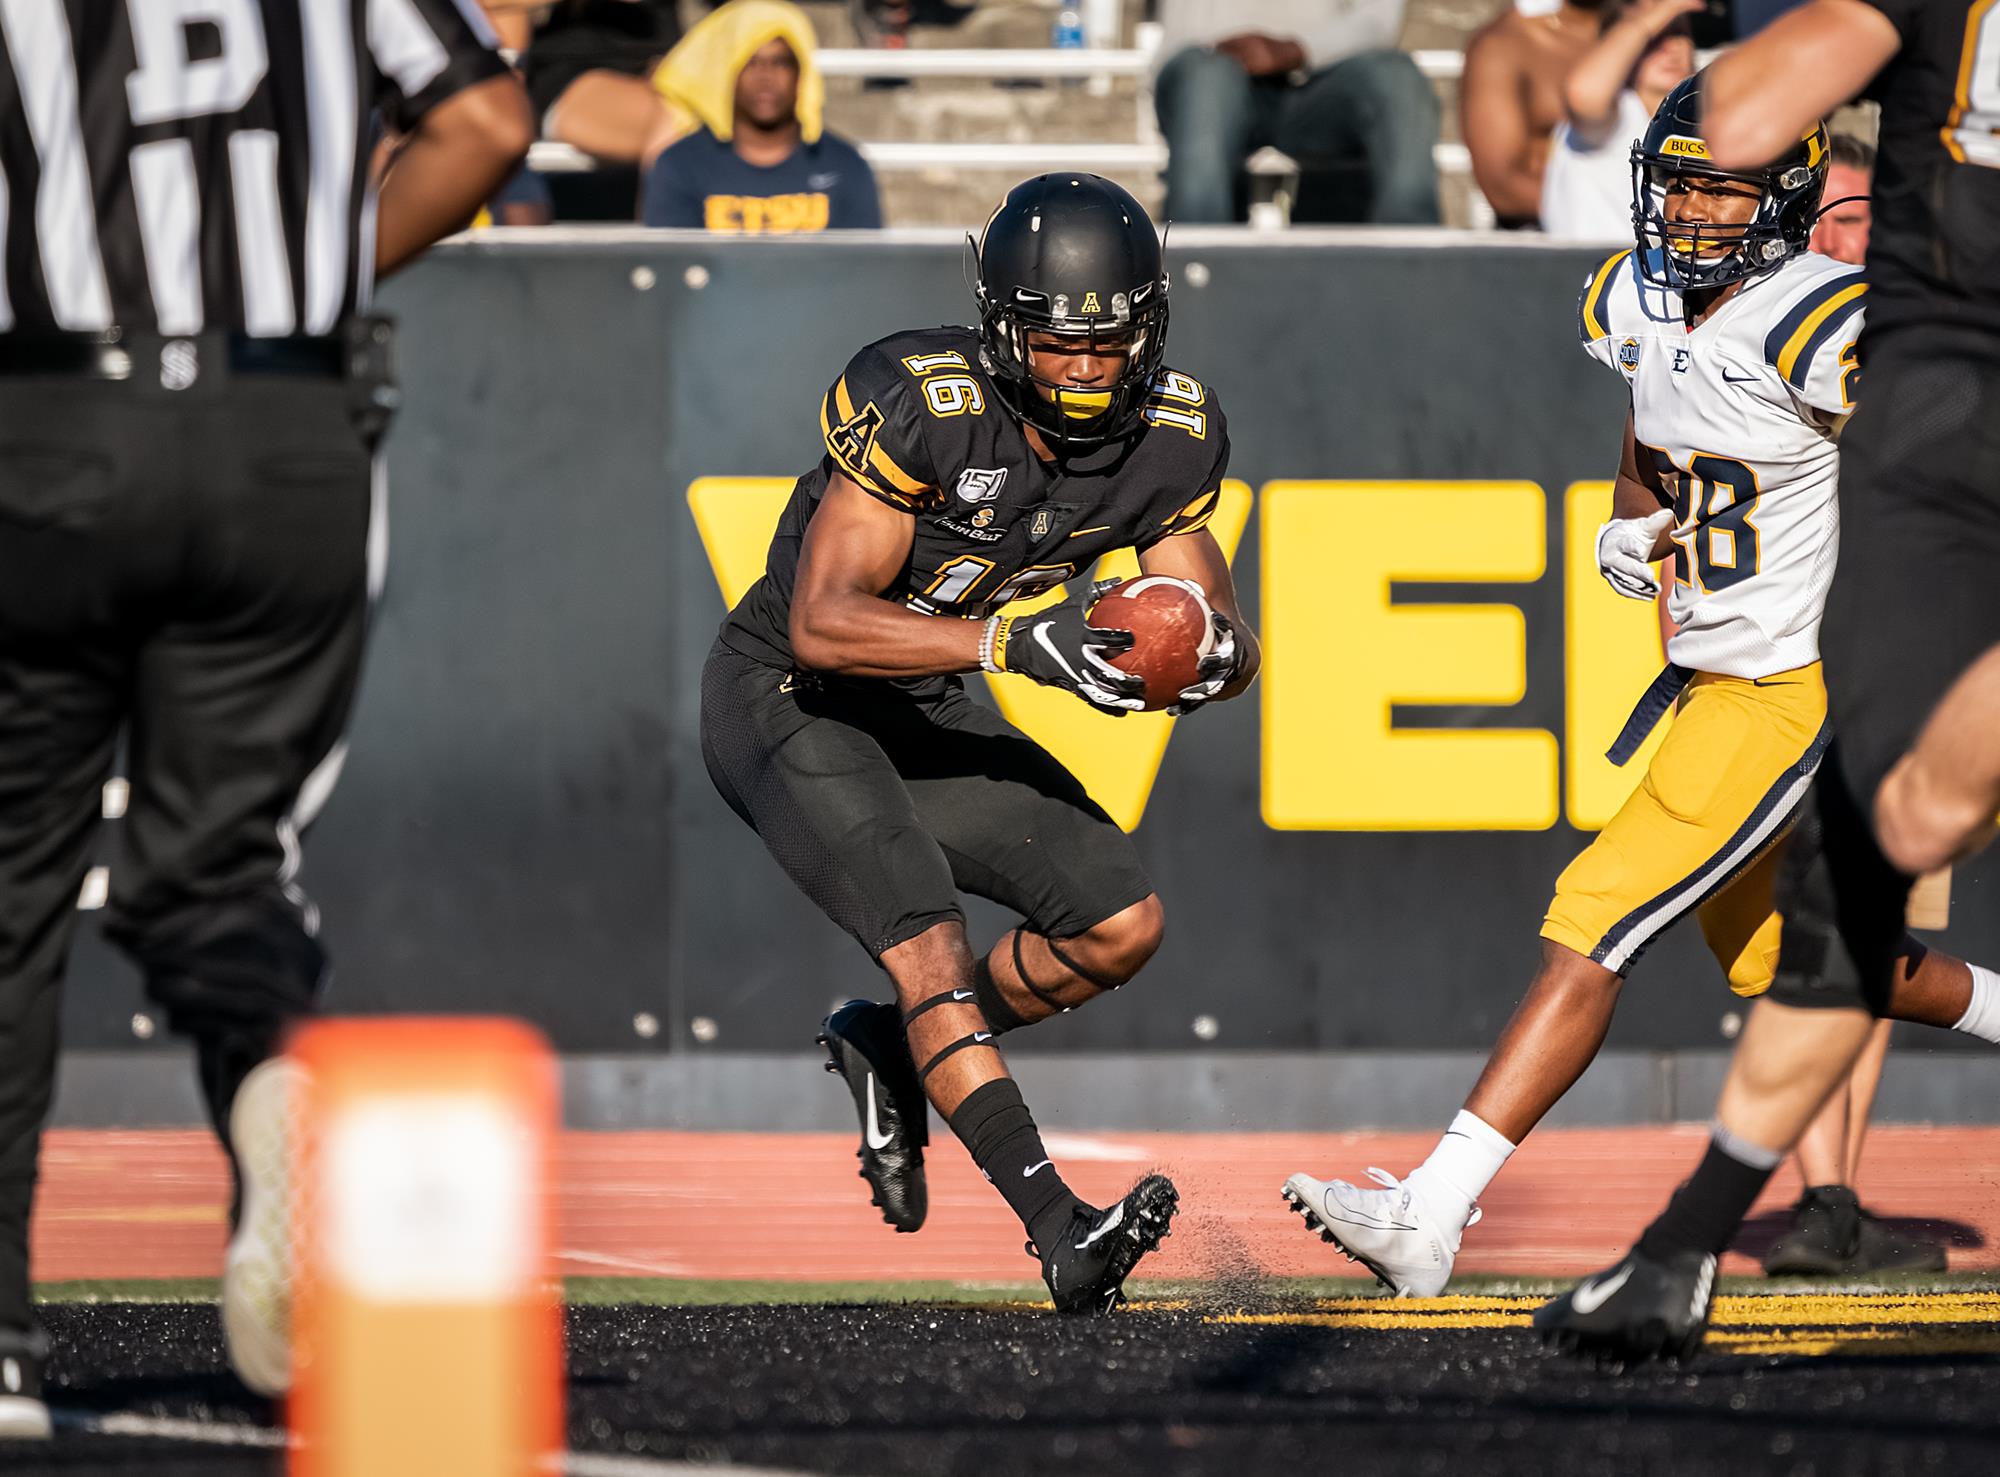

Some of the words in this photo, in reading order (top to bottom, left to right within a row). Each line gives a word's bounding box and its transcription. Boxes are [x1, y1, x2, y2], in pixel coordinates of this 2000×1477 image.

[1671, 140, 1705, 154] BUCS
[1081, 292, 1101, 313] A
[1672, 348, 1690, 374] E
[901, 350, 986, 418] 16
[1141, 370, 1207, 440] 16
[829, 400, 885, 473] A
[940, 519, 971, 535] SUN
